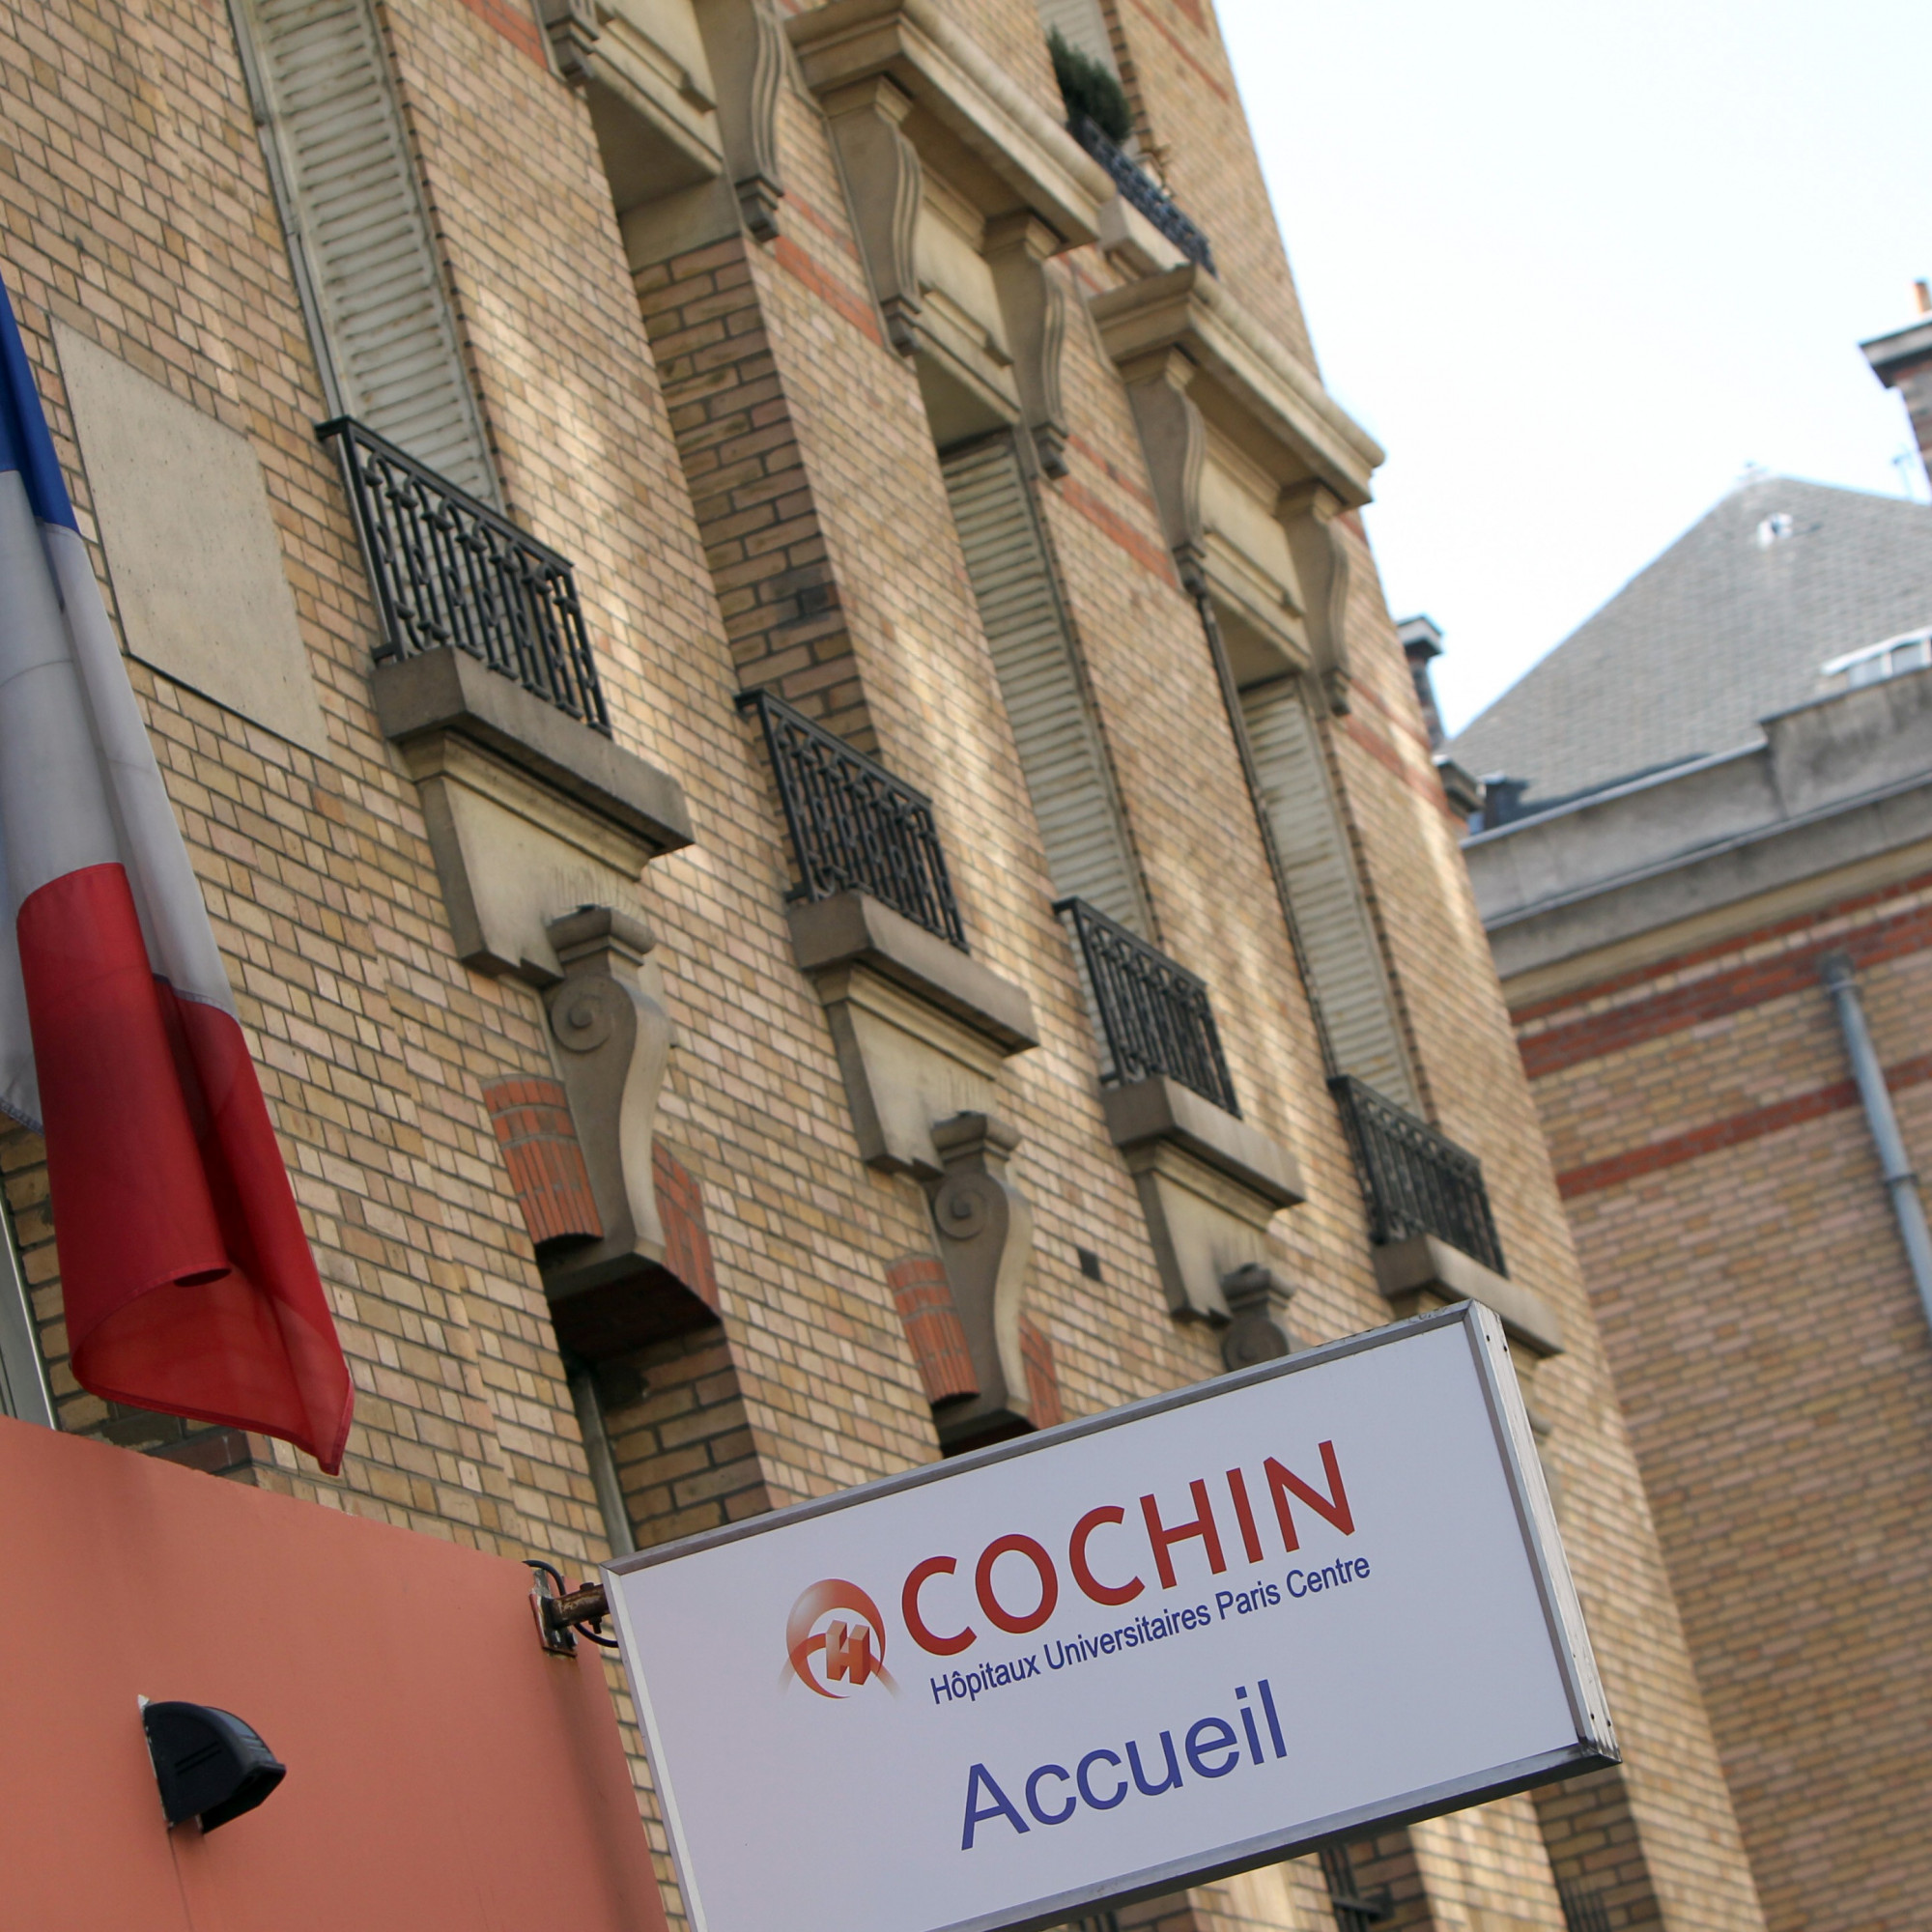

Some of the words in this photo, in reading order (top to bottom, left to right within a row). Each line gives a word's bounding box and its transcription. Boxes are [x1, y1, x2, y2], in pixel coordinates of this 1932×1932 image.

[900, 1439, 1355, 1657] COCHIN
[929, 1654, 1041, 1705] Hôpitaux
[1043, 1604, 1212, 1671] Universitaires
[1214, 1581, 1282, 1621] Paris
[1286, 1556, 1372, 1600] Centre
[960, 1679, 1289, 1852] Accueil
